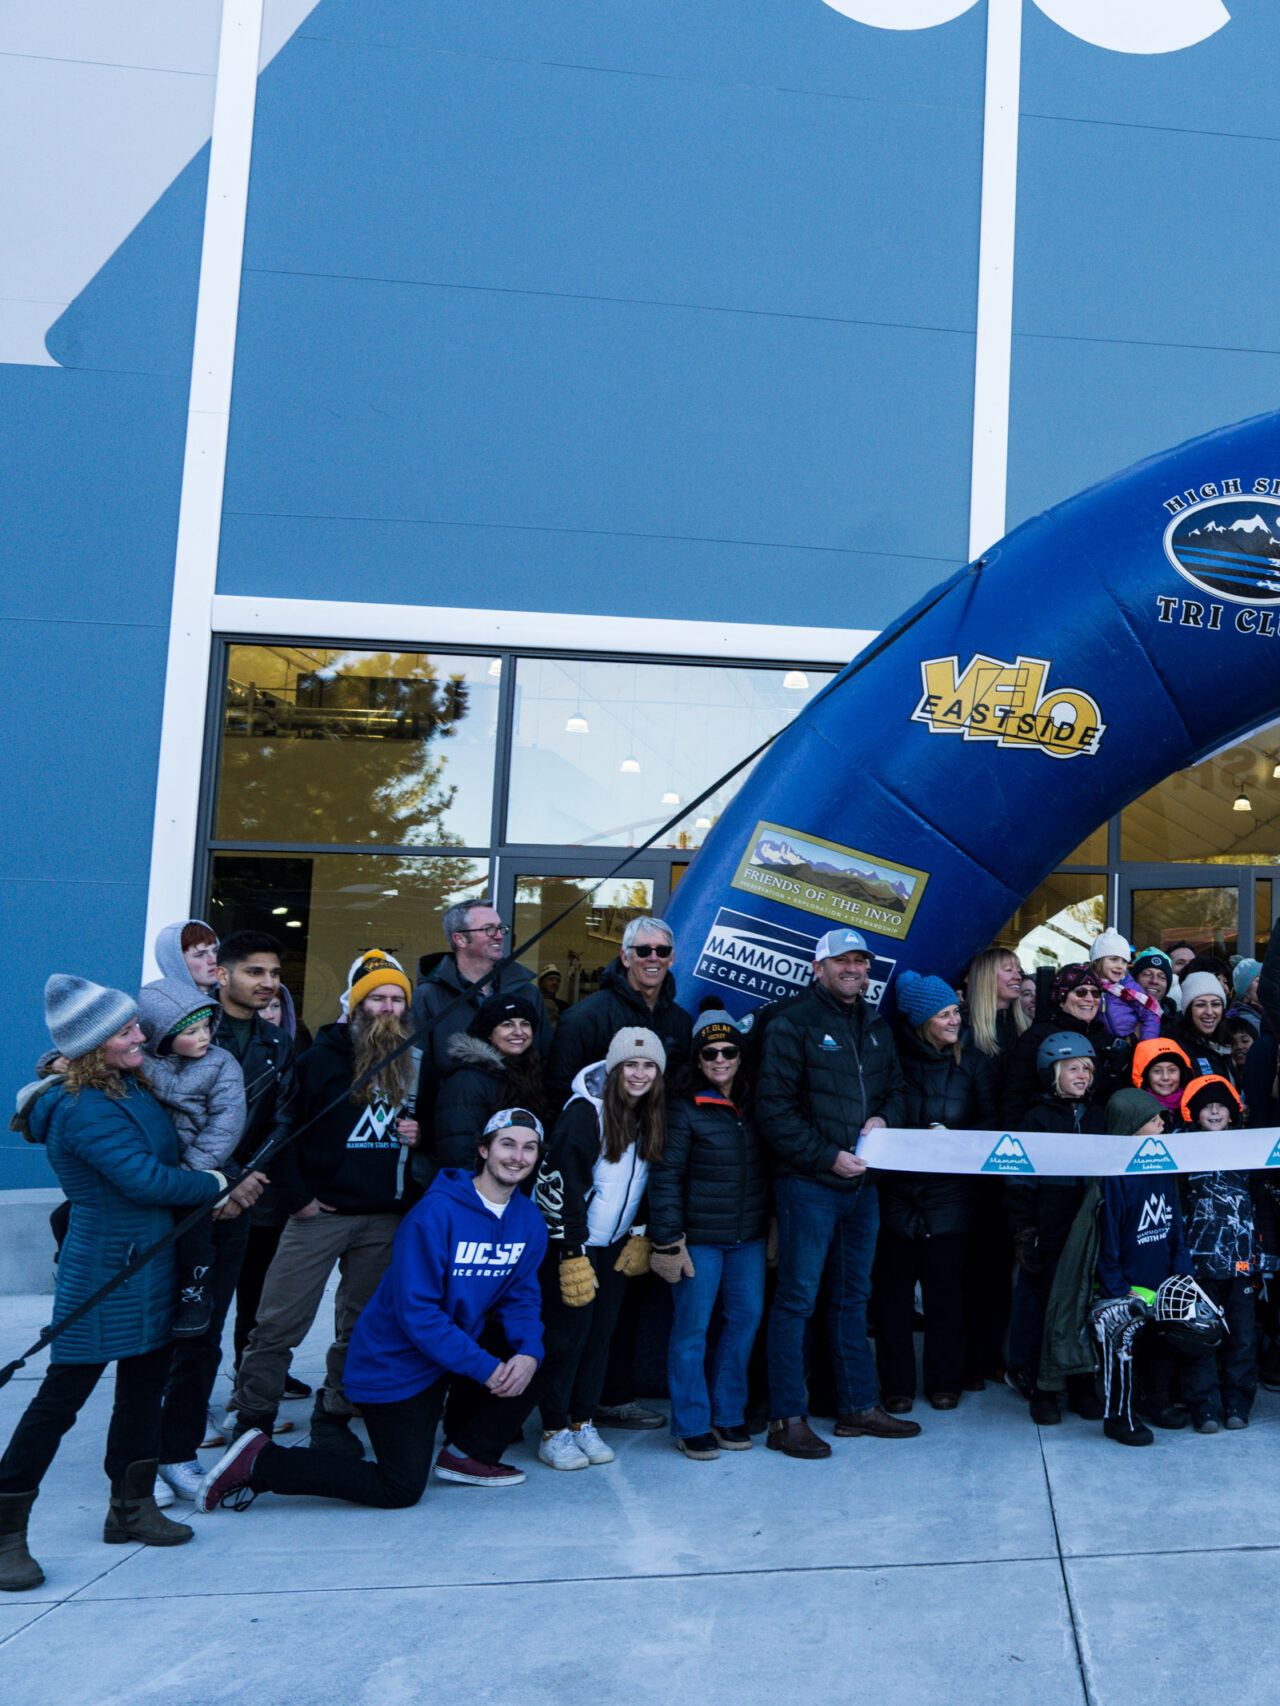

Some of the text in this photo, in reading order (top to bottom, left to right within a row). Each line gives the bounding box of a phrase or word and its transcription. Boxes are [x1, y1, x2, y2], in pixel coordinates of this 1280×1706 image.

[1162, 478, 1242, 516] HIGH
[1156, 595, 1224, 630] TRI
[920, 695, 1100, 746] EASTSIDE
[743, 868, 902, 926] FRIENDS OF THE INYO
[793, 898, 842, 917] EXPLORATION
[850, 916, 899, 934] STEWARDSHIP
[700, 960, 800, 997] RECREATION
[706, 936, 815, 986] MAMMOTH
[454, 1241, 526, 1266] UCSB
